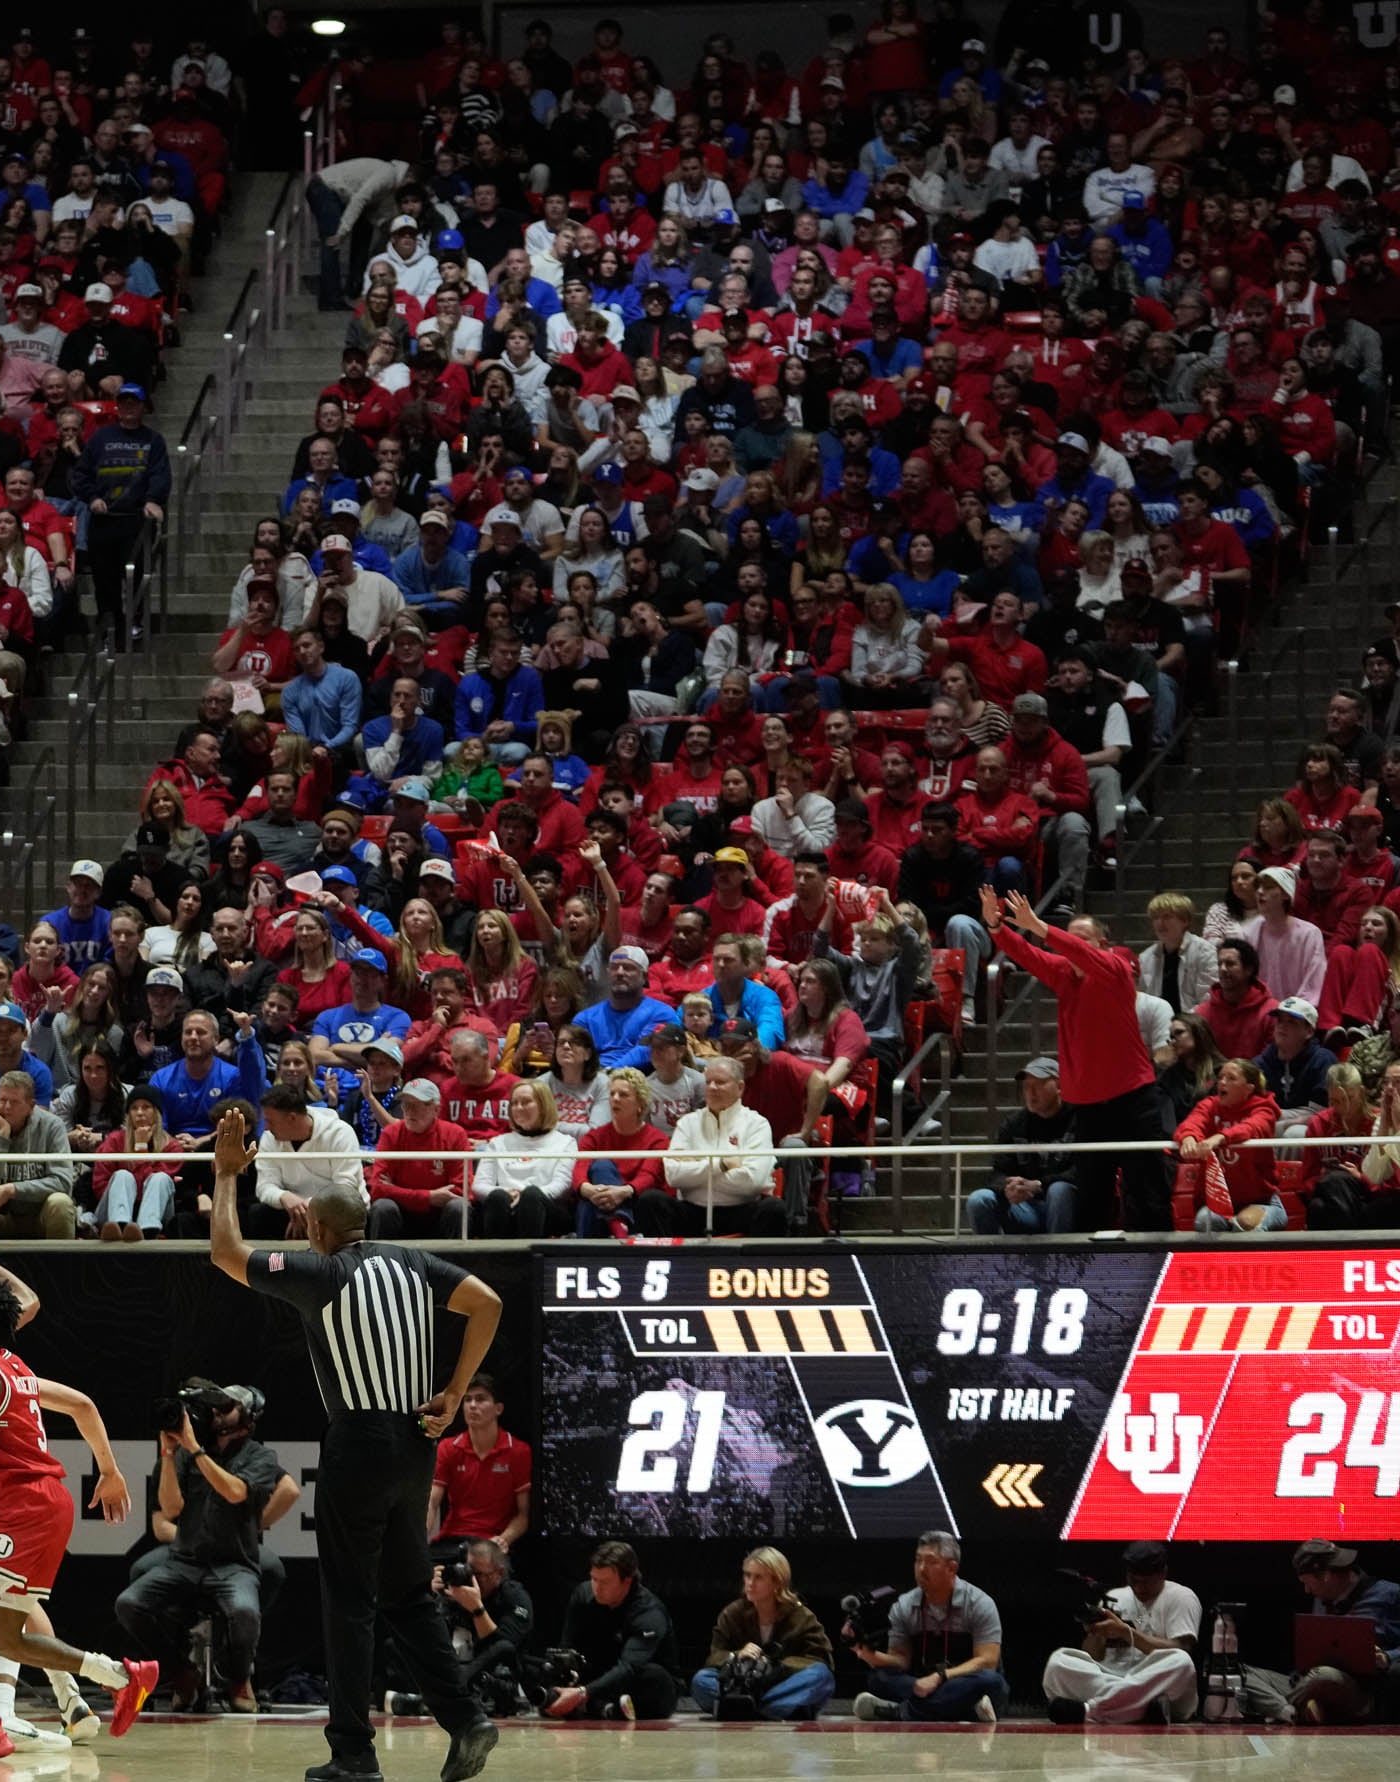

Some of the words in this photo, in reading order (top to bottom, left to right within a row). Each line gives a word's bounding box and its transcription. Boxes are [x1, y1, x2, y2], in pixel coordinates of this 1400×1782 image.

[1088, 13, 1122, 54] U
[449, 1100, 510, 1122] UTAH
[556, 1267, 621, 1299] FLS
[642, 1260, 671, 1301] 5
[709, 1268, 831, 1299] BONUS
[1343, 1259, 1400, 1293] FLS
[641, 1318, 697, 1345] TOL
[936, 1288, 1088, 1355] 9:18
[1327, 1314, 1385, 1341] TOL
[948, 1388, 998, 1421] 1ST
[1001, 1388, 1075, 1421] HALF
[616, 1390, 727, 1494] 21
[1275, 1391, 1400, 1498] 24
